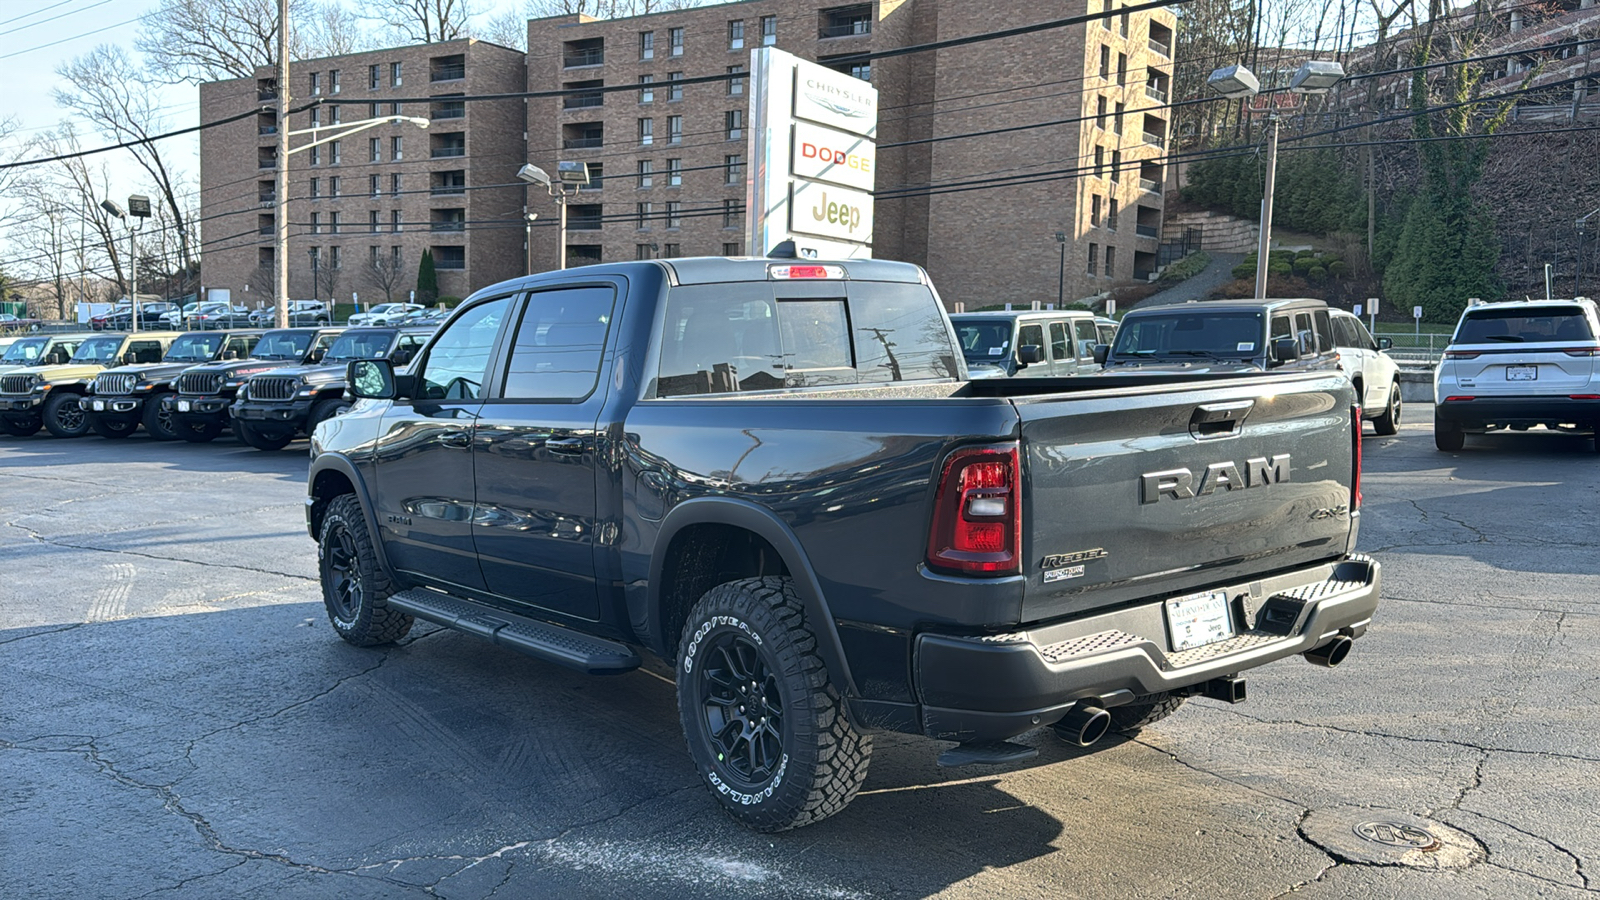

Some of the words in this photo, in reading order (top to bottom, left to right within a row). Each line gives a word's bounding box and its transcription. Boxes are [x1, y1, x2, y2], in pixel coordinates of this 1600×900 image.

[806, 79, 872, 107] CHRYSLER
[802, 142, 870, 172] DODGE
[812, 191, 860, 233] Jeep
[1138, 453, 1291, 505] RAM
[684, 615, 763, 674] GOODYEAR
[708, 753, 789, 806] WRANGLER
